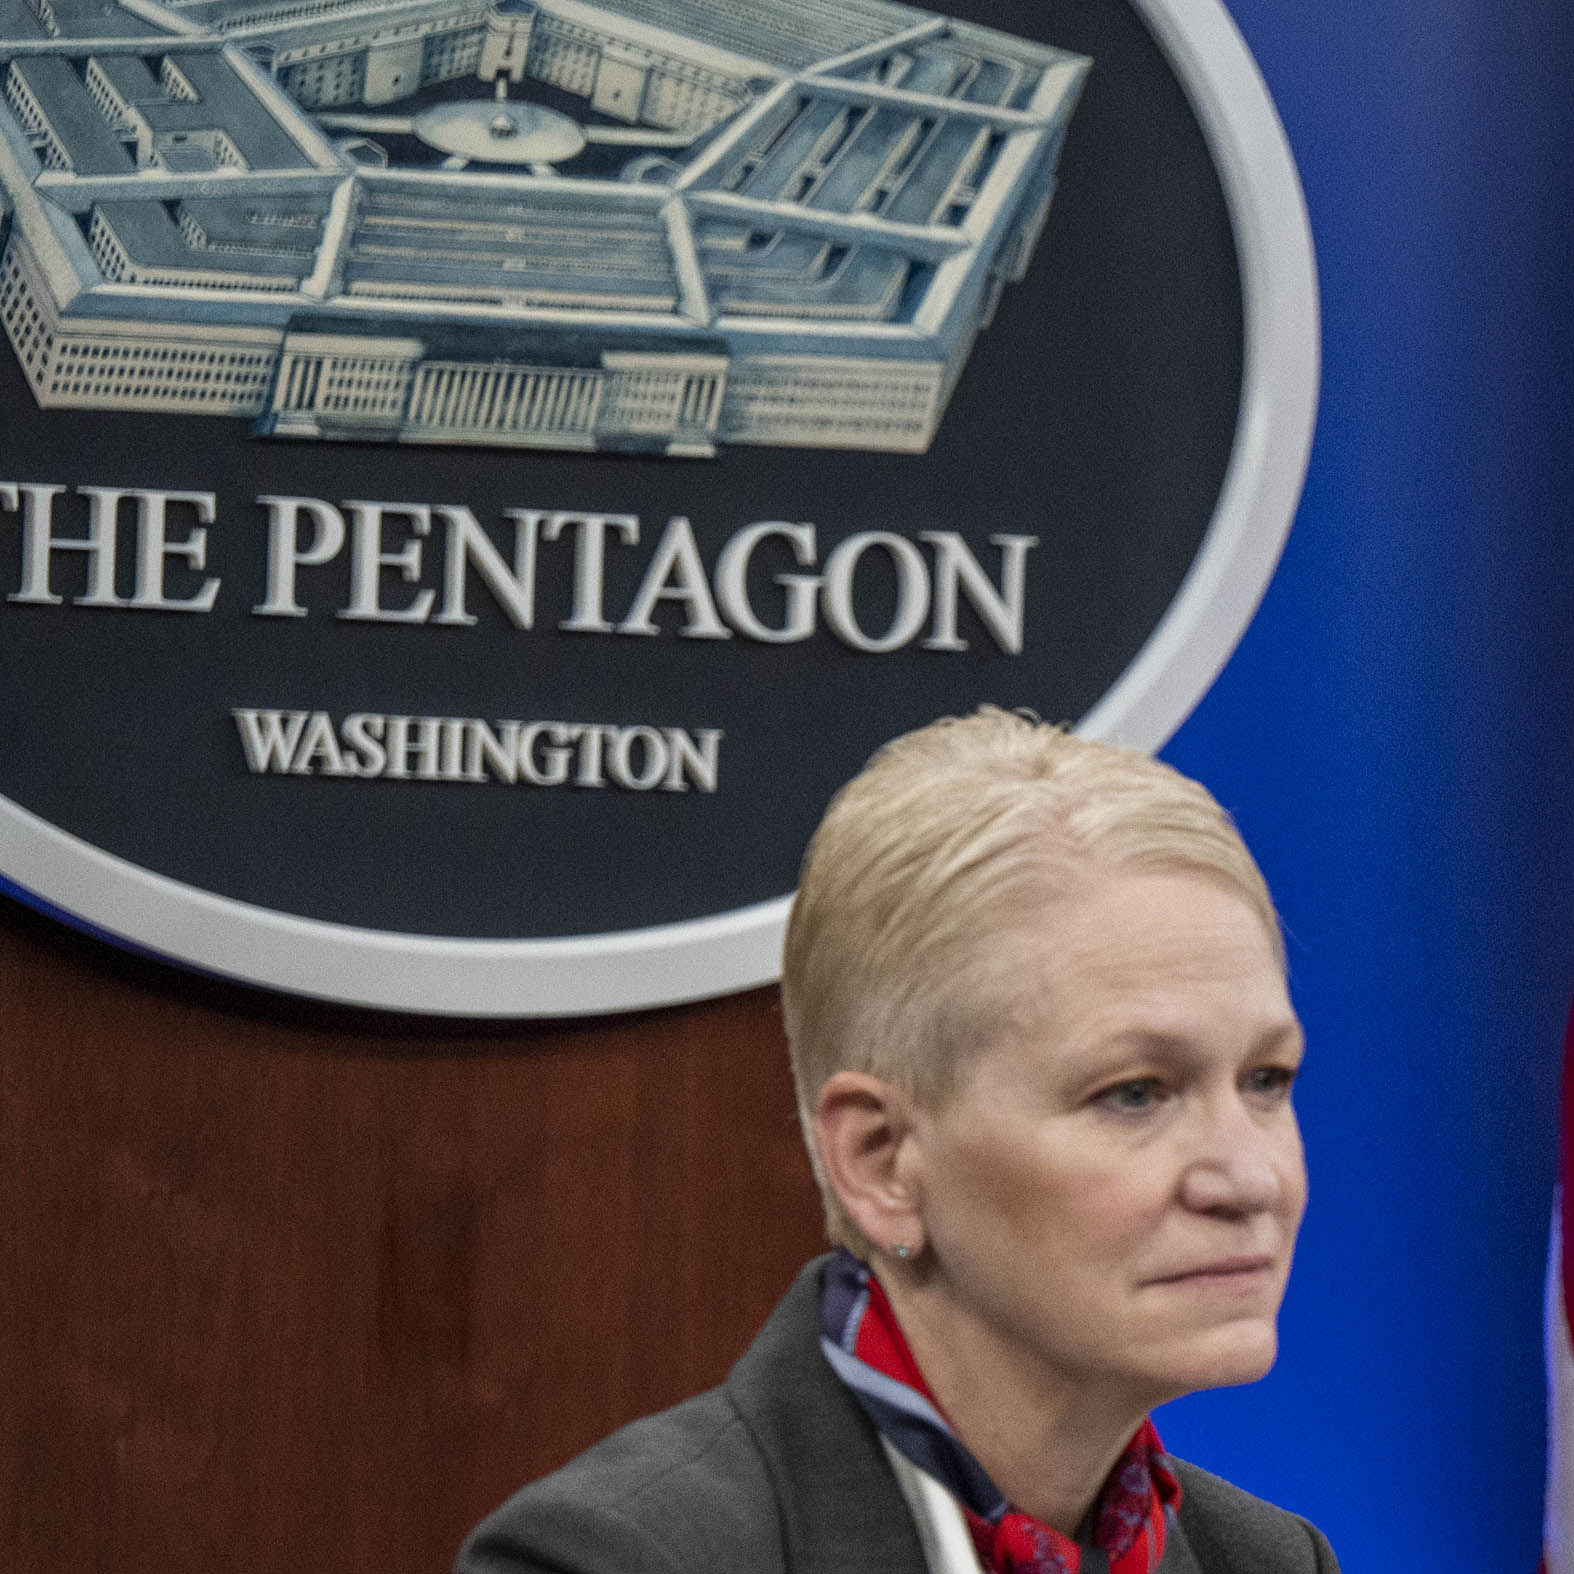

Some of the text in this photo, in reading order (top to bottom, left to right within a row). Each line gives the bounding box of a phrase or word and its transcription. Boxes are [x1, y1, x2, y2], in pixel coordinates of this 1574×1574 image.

[0, 481, 1040, 654] HE PENTAGON
[232, 707, 722, 792] WASHINGTON
